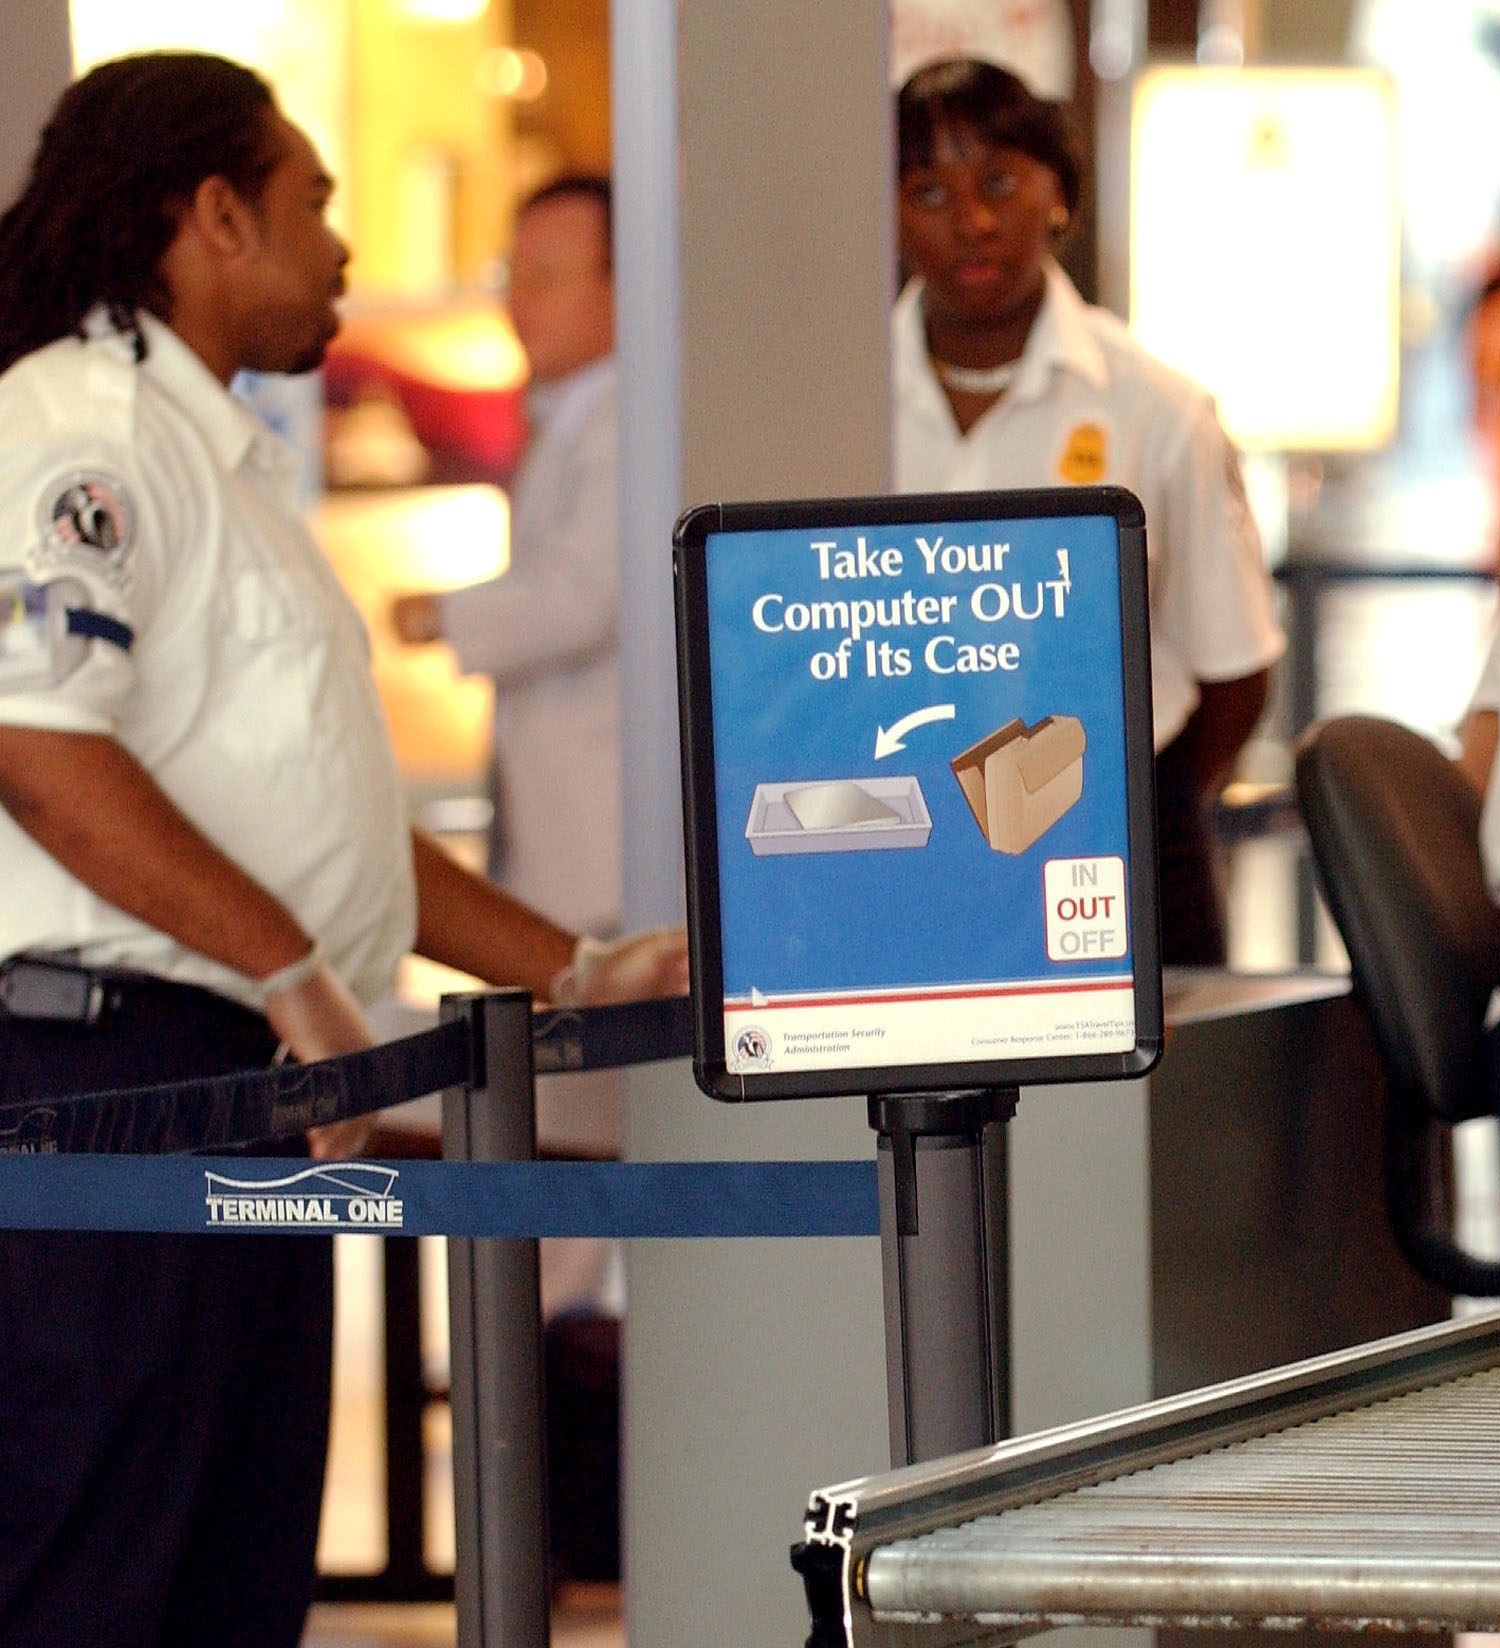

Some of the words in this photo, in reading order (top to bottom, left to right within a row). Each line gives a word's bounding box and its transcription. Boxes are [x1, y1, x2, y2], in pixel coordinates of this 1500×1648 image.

[810, 536, 904, 580] Take
[914, 536, 1010, 575] Your
[752, 590, 958, 641] Computer
[970, 580, 1071, 623] OUT
[810, 638, 853, 680] of
[866, 638, 912, 678] Its
[924, 635, 1020, 675] Case
[1072, 863, 1098, 887] IN
[1057, 895, 1116, 921] OUT
[1060, 929, 1116, 954] OFF
[783, 1031, 849, 1042] Transportation
[851, 1027, 886, 1038] Security
[784, 1043, 851, 1055] Administration
[205, 1199, 339, 1222] TERMINAL
[348, 1199, 404, 1223] ONE
